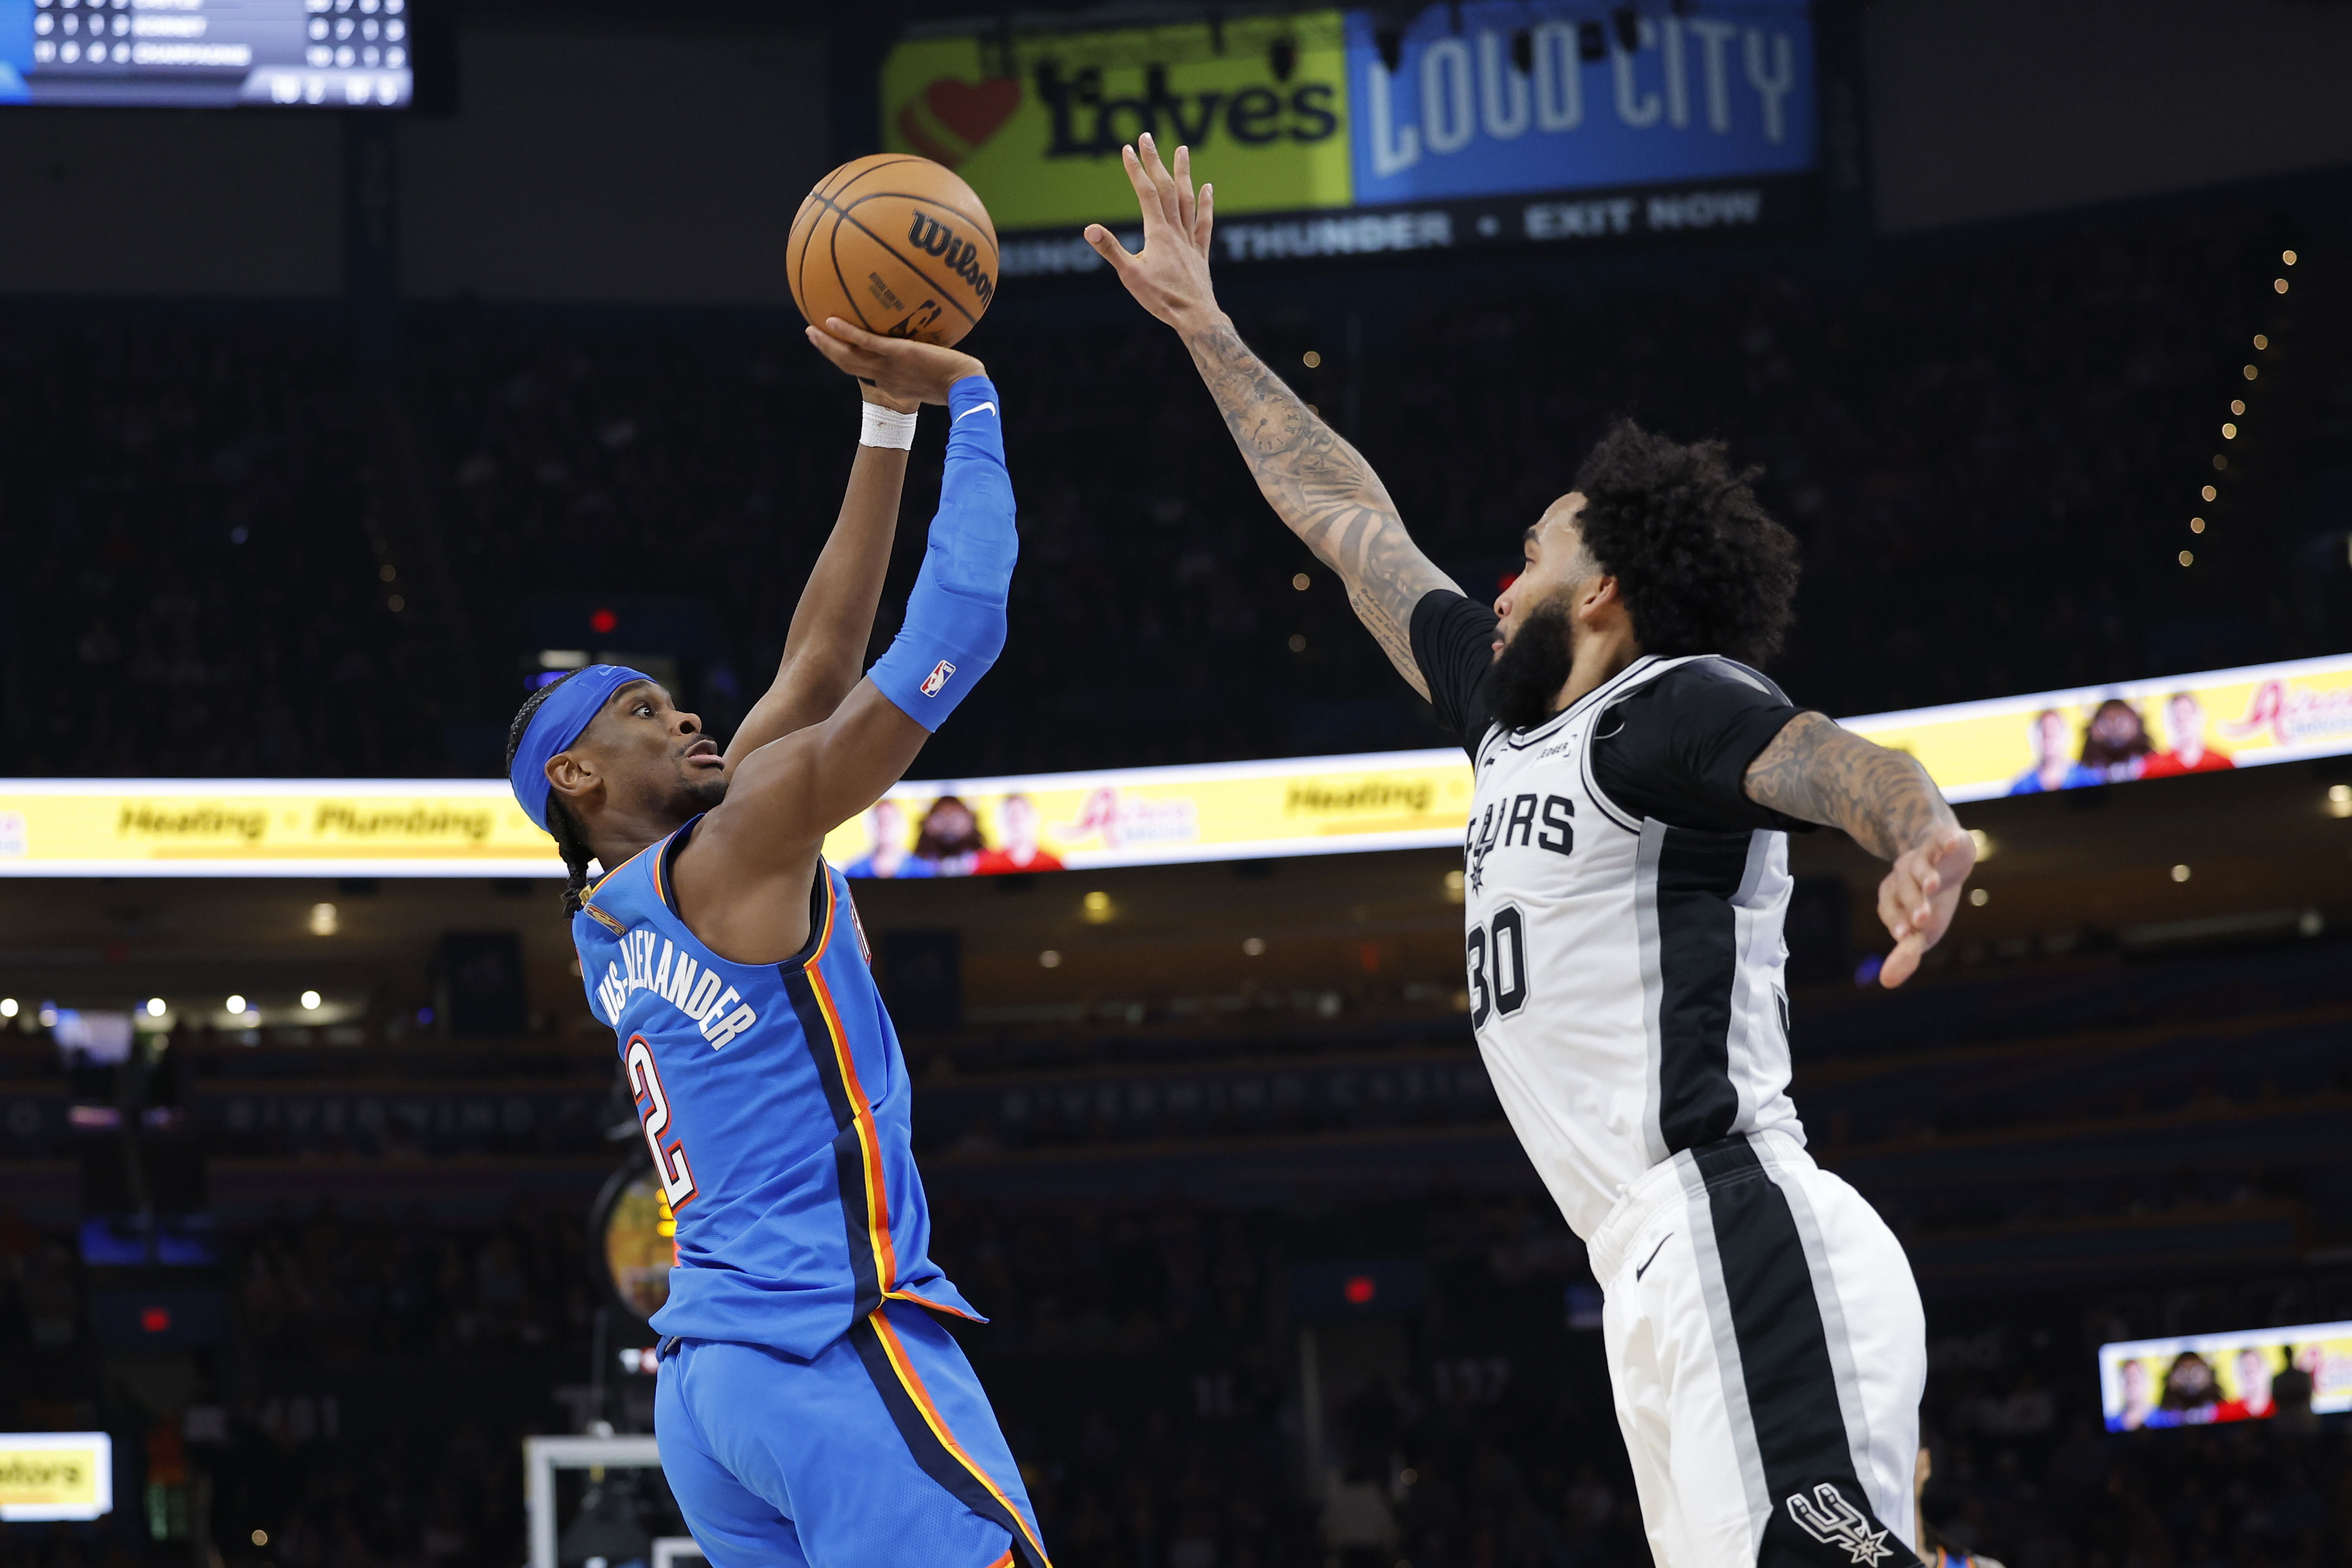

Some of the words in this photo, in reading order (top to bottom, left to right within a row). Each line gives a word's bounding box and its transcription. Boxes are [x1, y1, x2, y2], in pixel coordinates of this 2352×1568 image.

[1369, 20, 1583, 178] LOUD
[1610, 16, 1793, 145] CITY
[908, 210, 993, 310] Wilson
[1222, 211, 1452, 262] THUNDER
[1523, 198, 1637, 240] EXIT
[1645, 188, 1762, 232] NOW
[117, 804, 267, 842] Heating
[314, 803, 494, 843] Plumbing
[1287, 779, 1433, 814] Heating
[1466, 901, 1530, 1038] 30
[624, 1034, 699, 1216] 2
